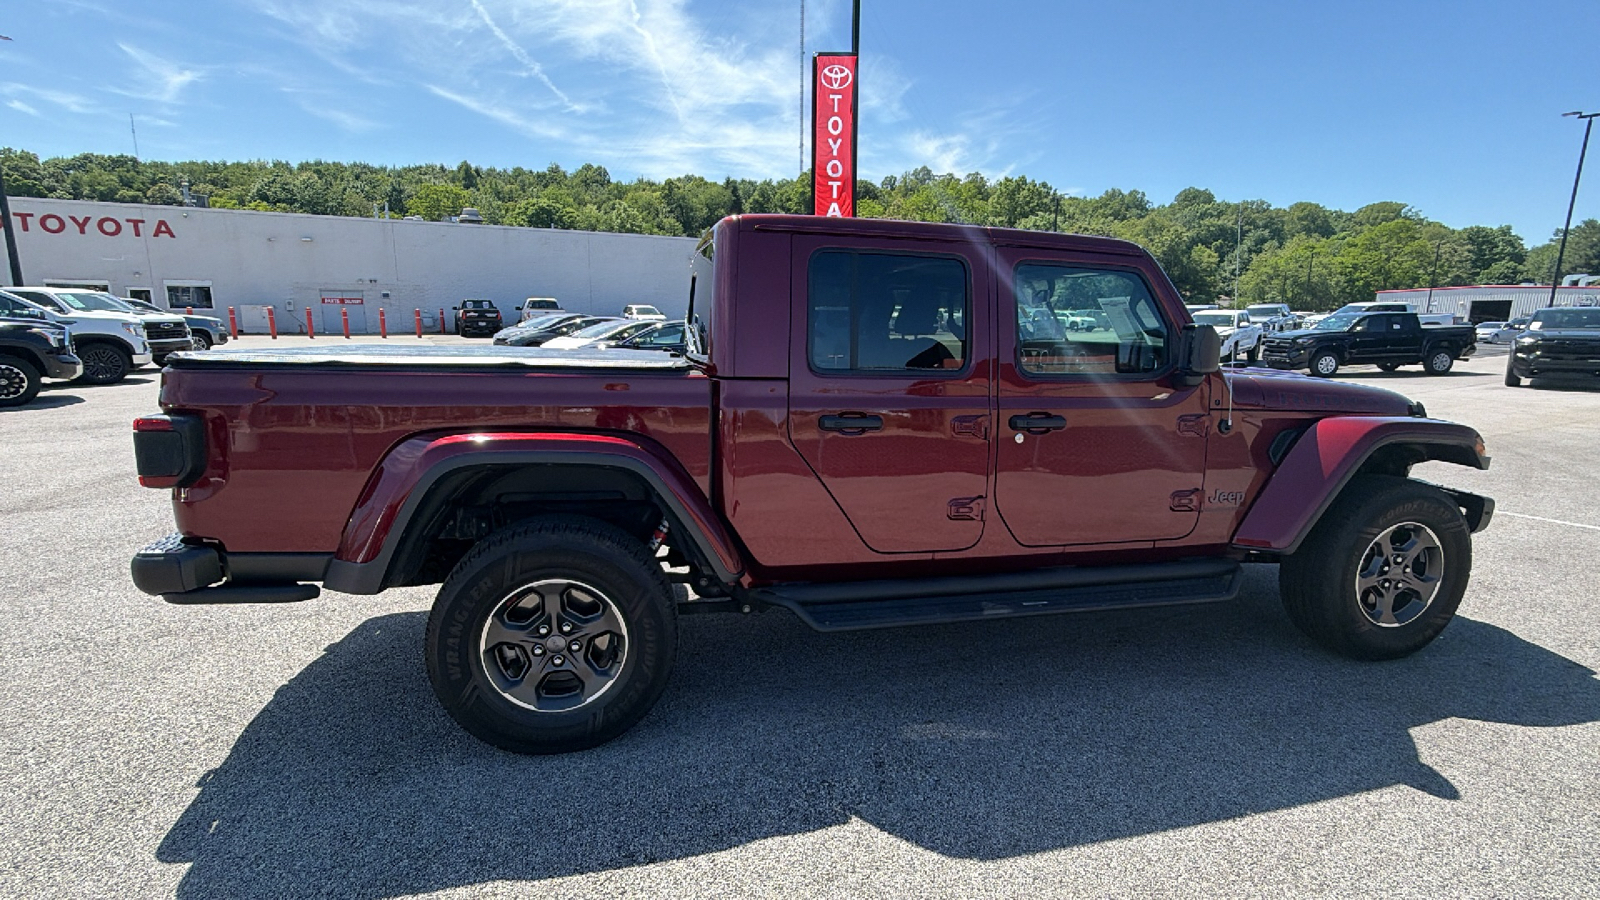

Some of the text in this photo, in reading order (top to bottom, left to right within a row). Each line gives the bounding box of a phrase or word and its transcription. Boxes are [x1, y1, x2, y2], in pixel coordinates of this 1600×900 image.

[826, 94, 843, 218] TOYOTA
[12, 212, 176, 239] TOYOTA
[1208, 489, 1246, 507] Jeep
[445, 577, 494, 681] WRANGLER
